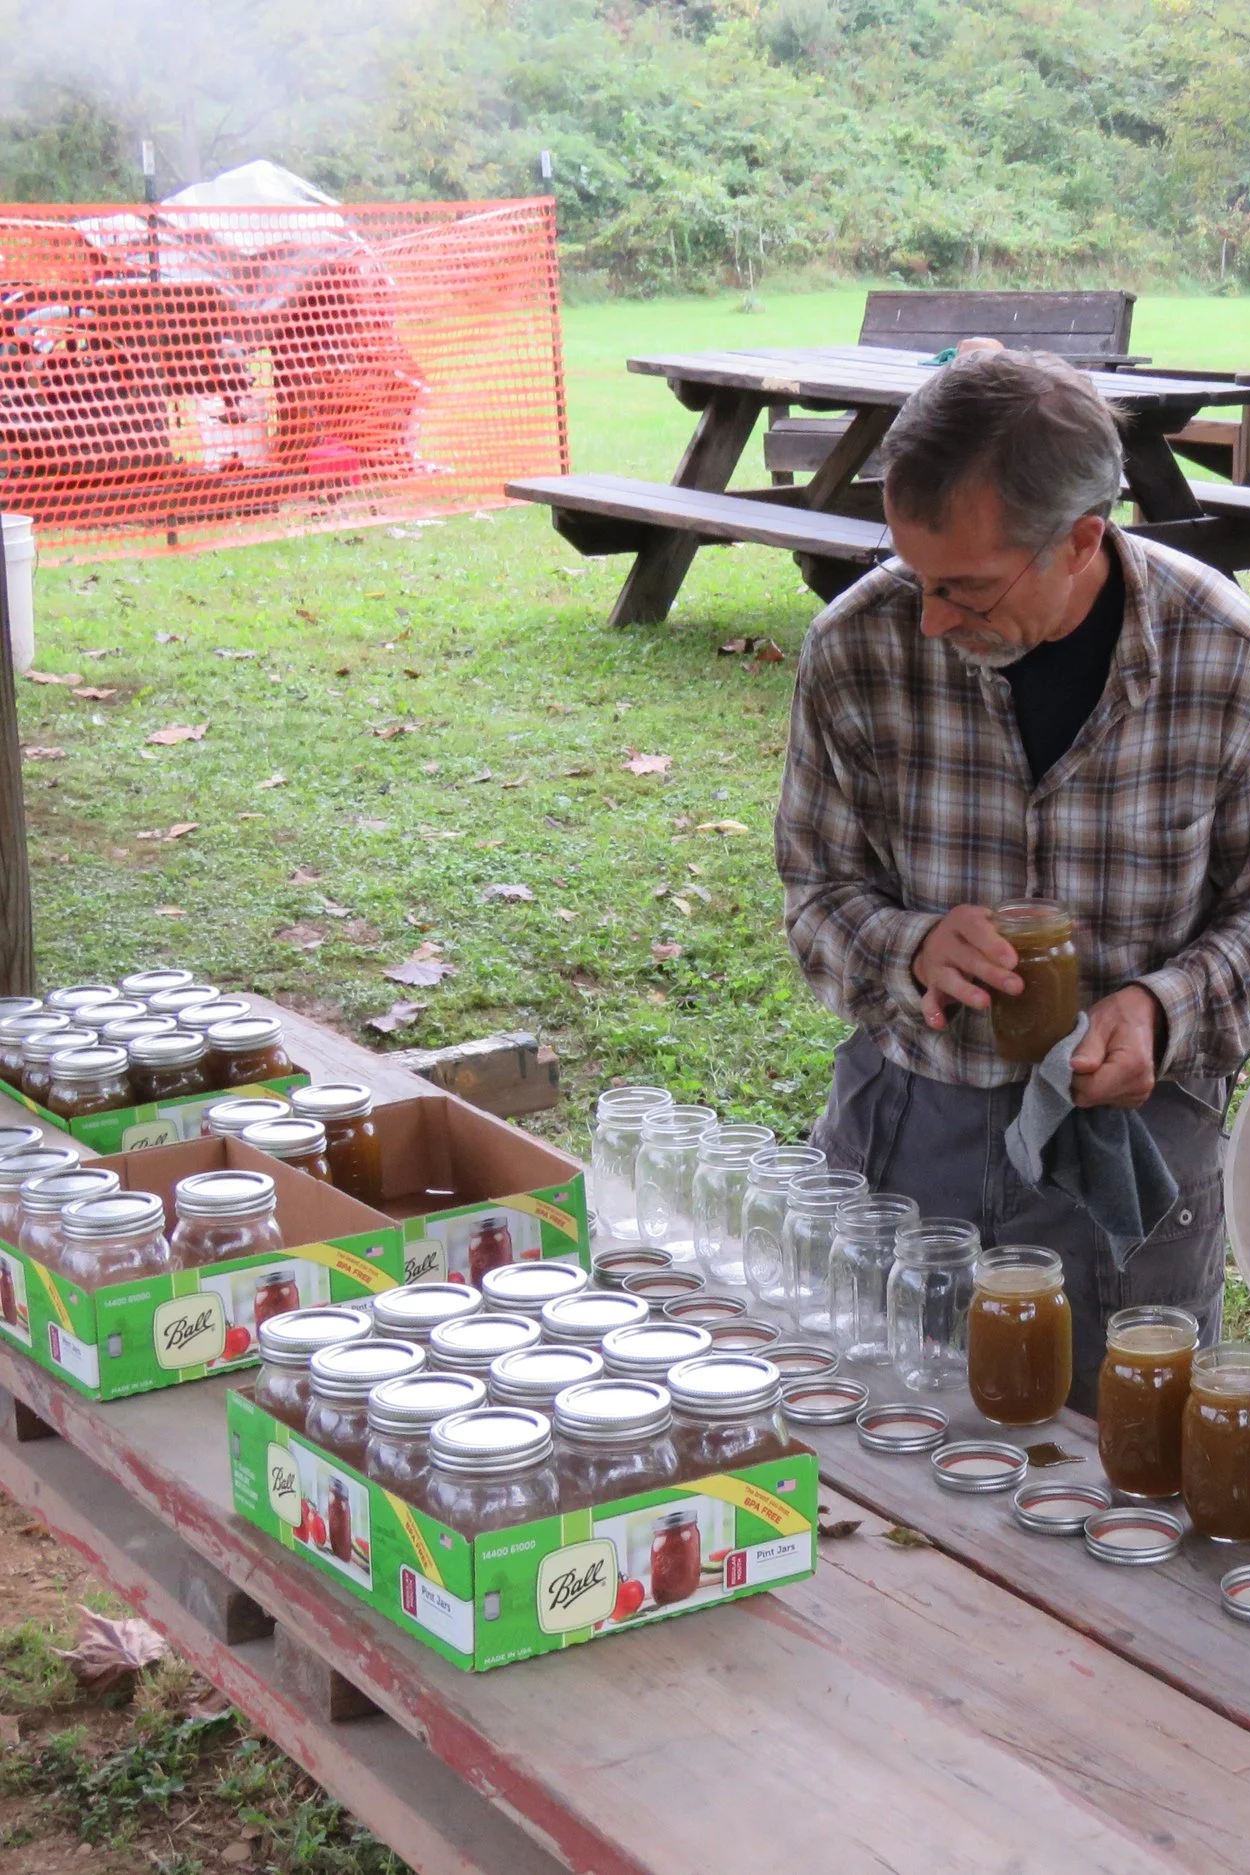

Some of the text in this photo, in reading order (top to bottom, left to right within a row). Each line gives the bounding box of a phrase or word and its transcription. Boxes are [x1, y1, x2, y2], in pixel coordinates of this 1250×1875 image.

[130, 1132, 168, 1150] Bll
[404, 1251, 438, 1285] Ball
[163, 1309, 215, 1351] Ball
[271, 1466, 296, 1498] Ball
[743, 1496, 782, 1525] BPA FREE
[482, 1540, 536, 1560] 14400 61000
[756, 1543, 796, 1560] Pint Jars
[549, 1559, 607, 1610] Ball
